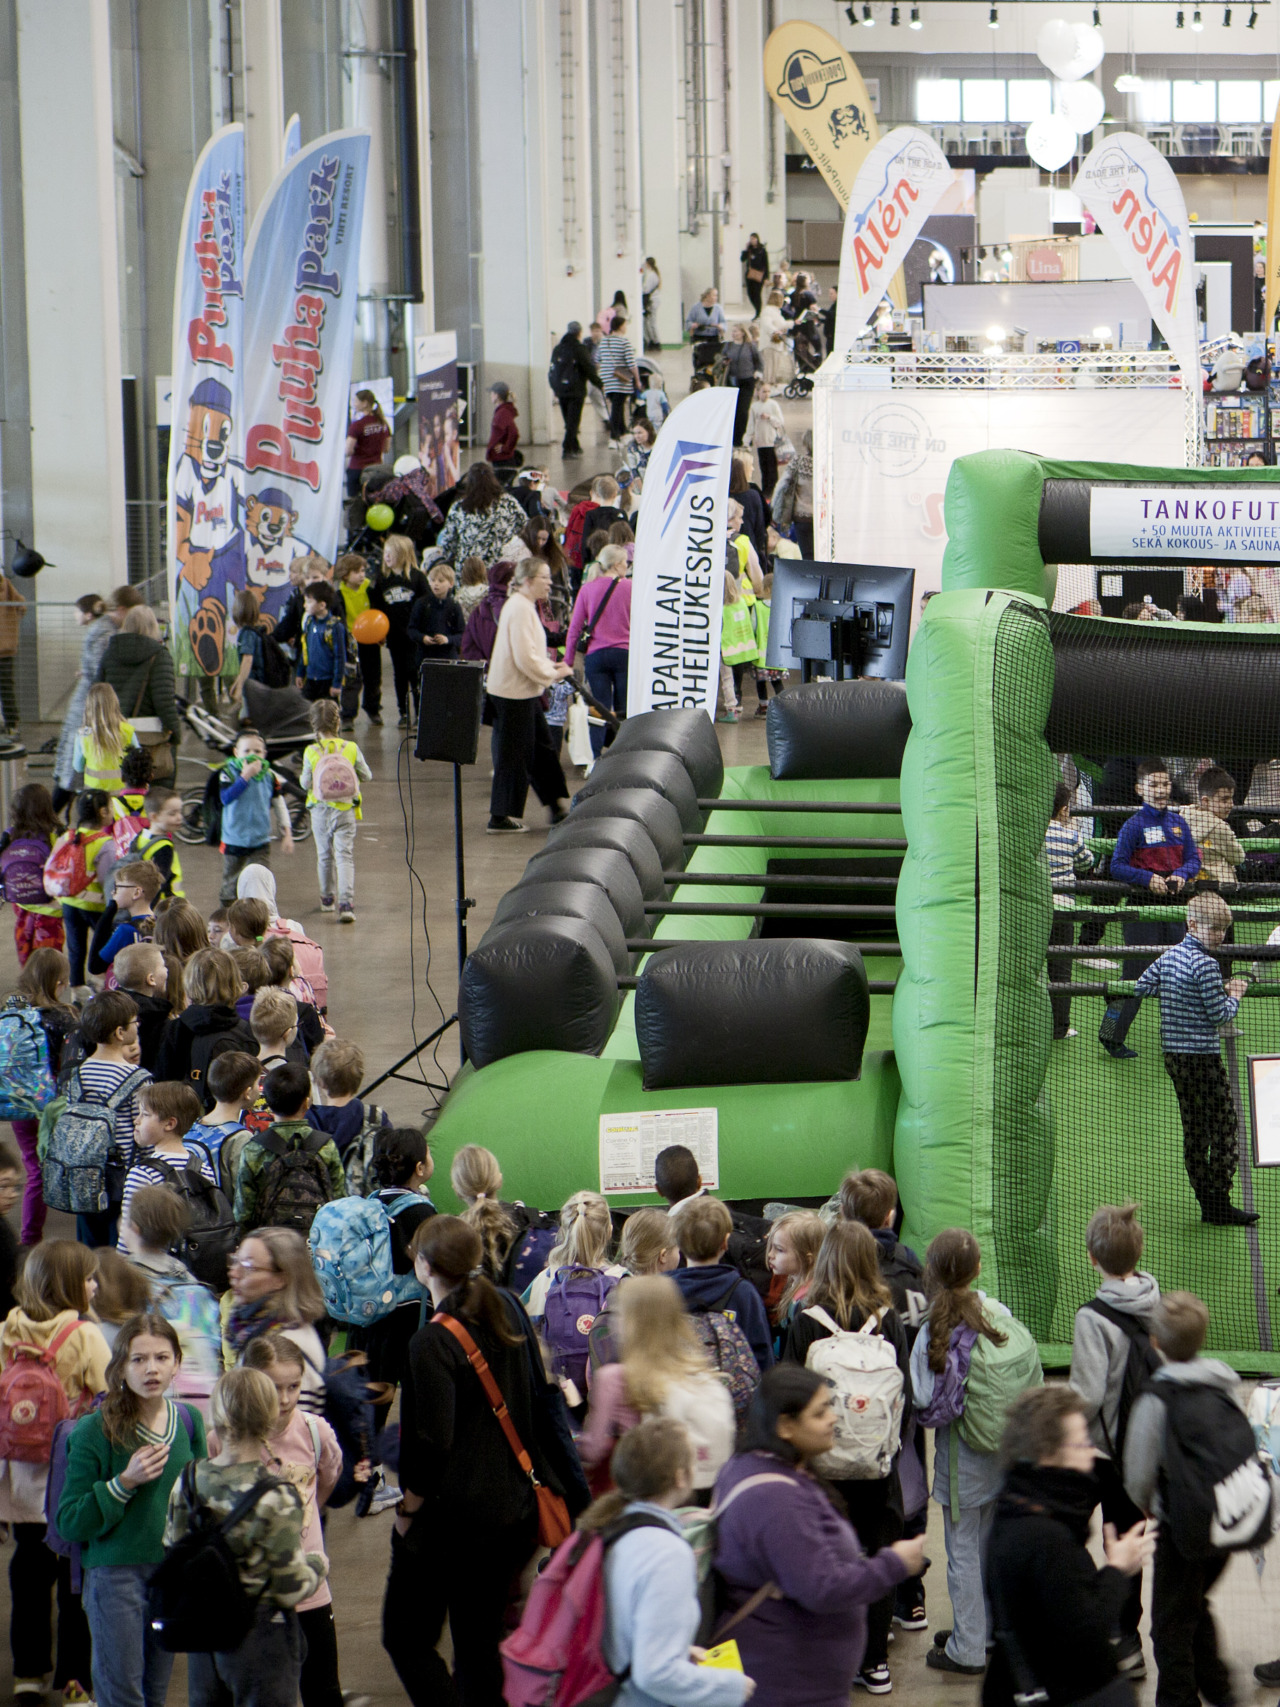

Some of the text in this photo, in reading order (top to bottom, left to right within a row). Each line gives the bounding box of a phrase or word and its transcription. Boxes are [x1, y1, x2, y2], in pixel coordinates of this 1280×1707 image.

[297, 153, 341, 297] Park
[340, 164, 355, 214] RESORT
[853, 178, 920, 295] Alén
[1031, 259, 1060, 274] Lina
[245, 294, 327, 492] Puuha
[1131, 534, 1163, 549] SEKÄ
[1166, 537, 1220, 550] KOKOUS-
[1223, 539, 1237, 551] JA
[1140, 527, 1148, 536] +
[1151, 524, 1167, 537] 50
[1170, 525, 1213, 538] MUUTA
[651, 574, 682, 711] APANILAN
[682, 495, 715, 711] RHEILUKESKUS
